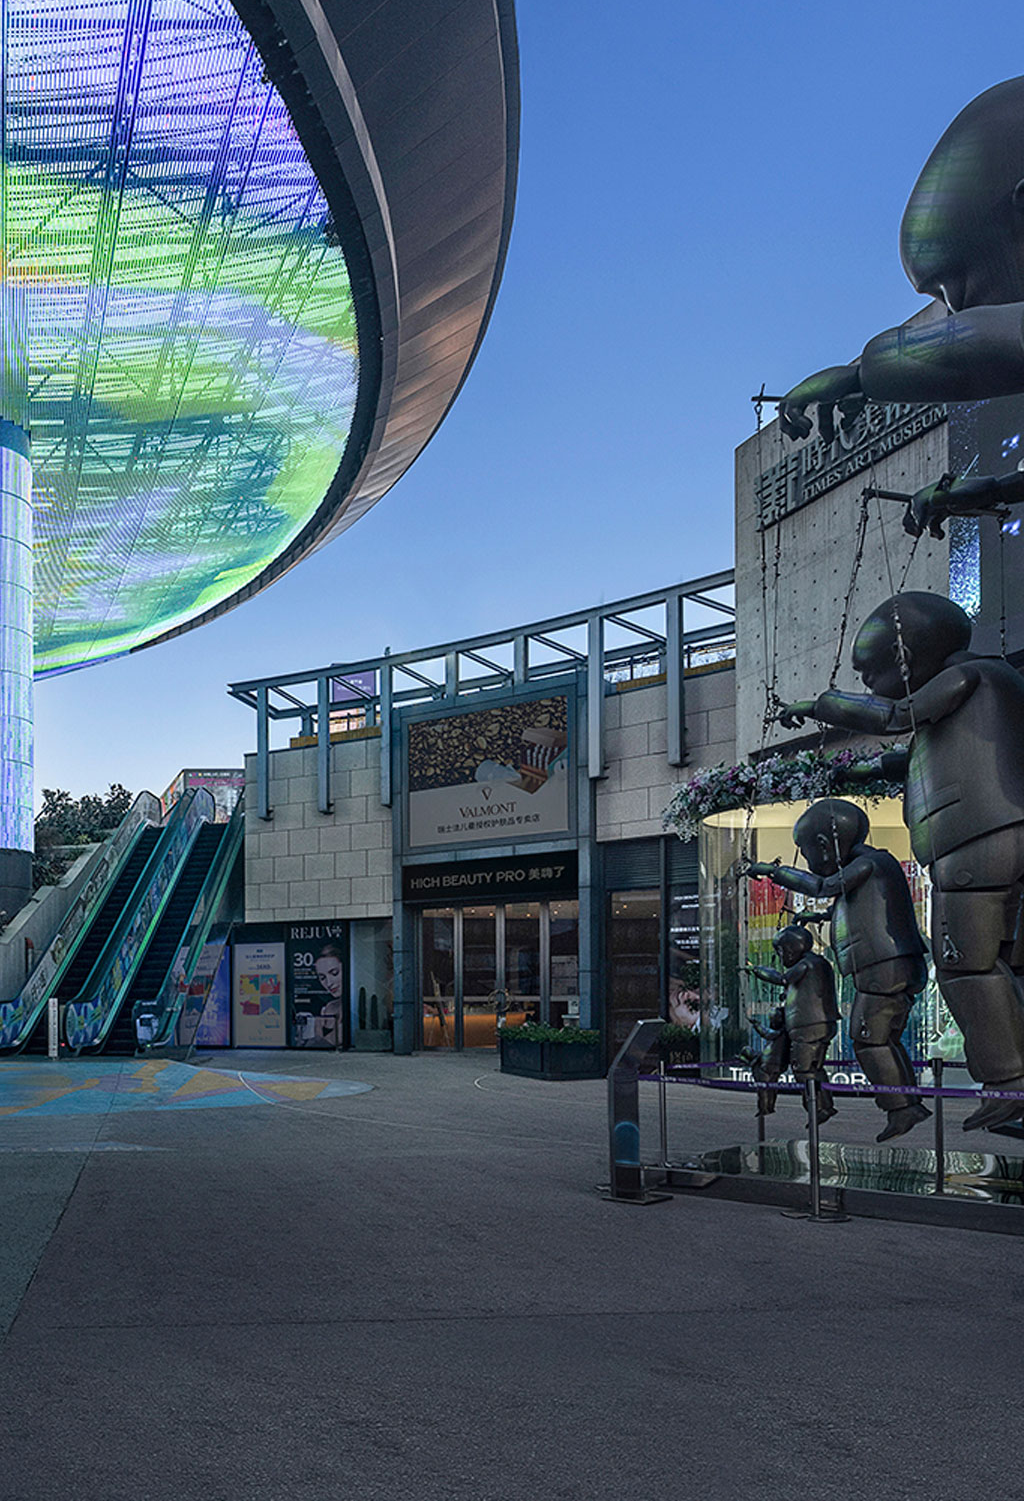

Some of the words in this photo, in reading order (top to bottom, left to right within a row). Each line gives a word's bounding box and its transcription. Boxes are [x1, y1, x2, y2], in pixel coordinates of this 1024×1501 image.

[802, 468, 843, 501] TIMES
[845, 451, 873, 476] ART
[878, 404, 948, 455] MUSEUM
[459, 802, 517, 818] VALMONT
[442, 872, 493, 887] BEAUTY
[496, 870, 526, 883] PRO
[293, 952, 314, 967] 30
